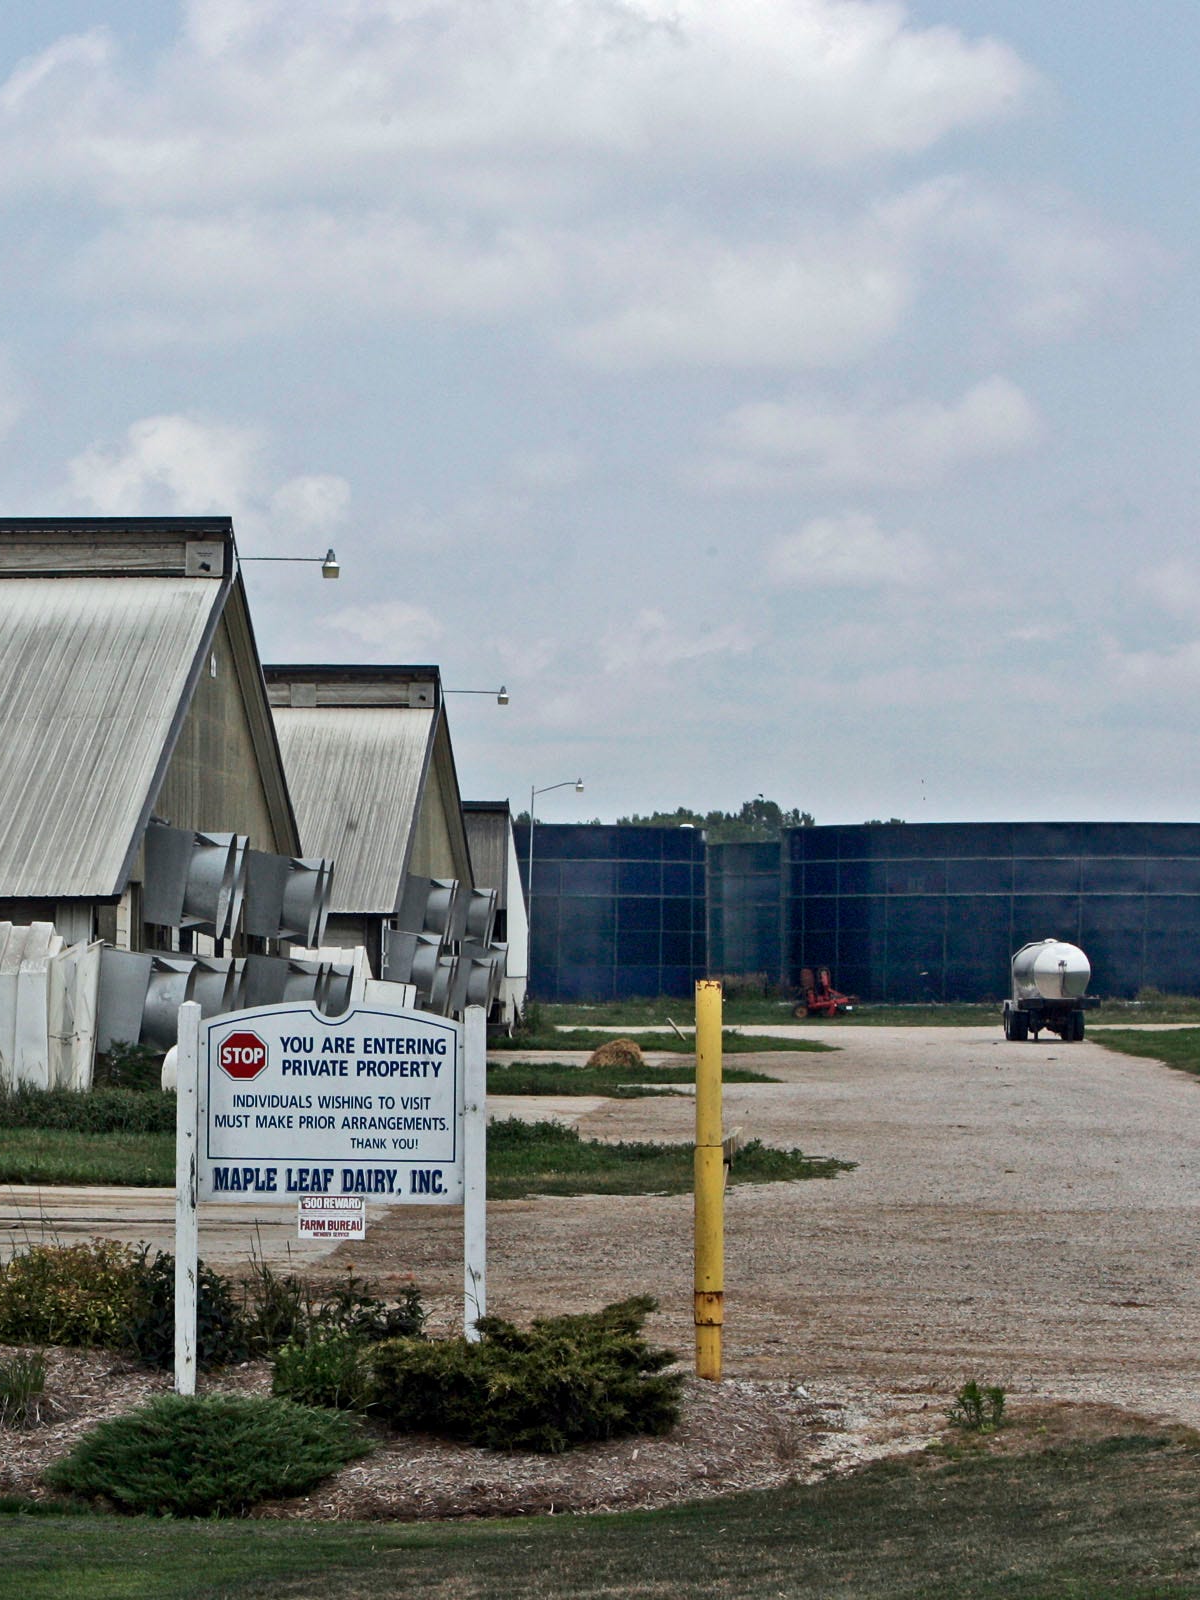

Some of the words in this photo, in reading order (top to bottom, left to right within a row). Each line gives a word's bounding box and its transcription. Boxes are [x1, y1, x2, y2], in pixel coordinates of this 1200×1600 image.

[280, 1037, 313, 1053] YOU
[322, 1037, 355, 1053] ARE
[364, 1038, 446, 1055] ENTERING
[223, 1047, 263, 1064] STOP
[282, 1060, 348, 1076] PRIVATE
[357, 1061, 442, 1077] PROPERTY
[233, 1095, 312, 1108] INDIVIDUALS
[318, 1096, 372, 1109] WISHING
[378, 1096, 395, 1109] TO
[401, 1097, 431, 1110] VISIT
[215, 1115, 250, 1128] MUST
[256, 1115, 293, 1128] MAKE
[299, 1116, 335, 1129] PRIOR
[341, 1117, 449, 1130] ARRANGEMENTS.
[351, 1138, 386, 1149] THANK
[392, 1139, 418, 1149] YOU!
[212, 1167, 277, 1192] MAPLE
[285, 1168, 334, 1193] LEAF
[341, 1169, 401, 1195] DAIRY,
[410, 1170, 447, 1194] INC.
[324, 1198, 361, 1208] REWARD
[301, 1219, 325, 1230] FARM
[328, 1219, 362, 1231] BUREAU
